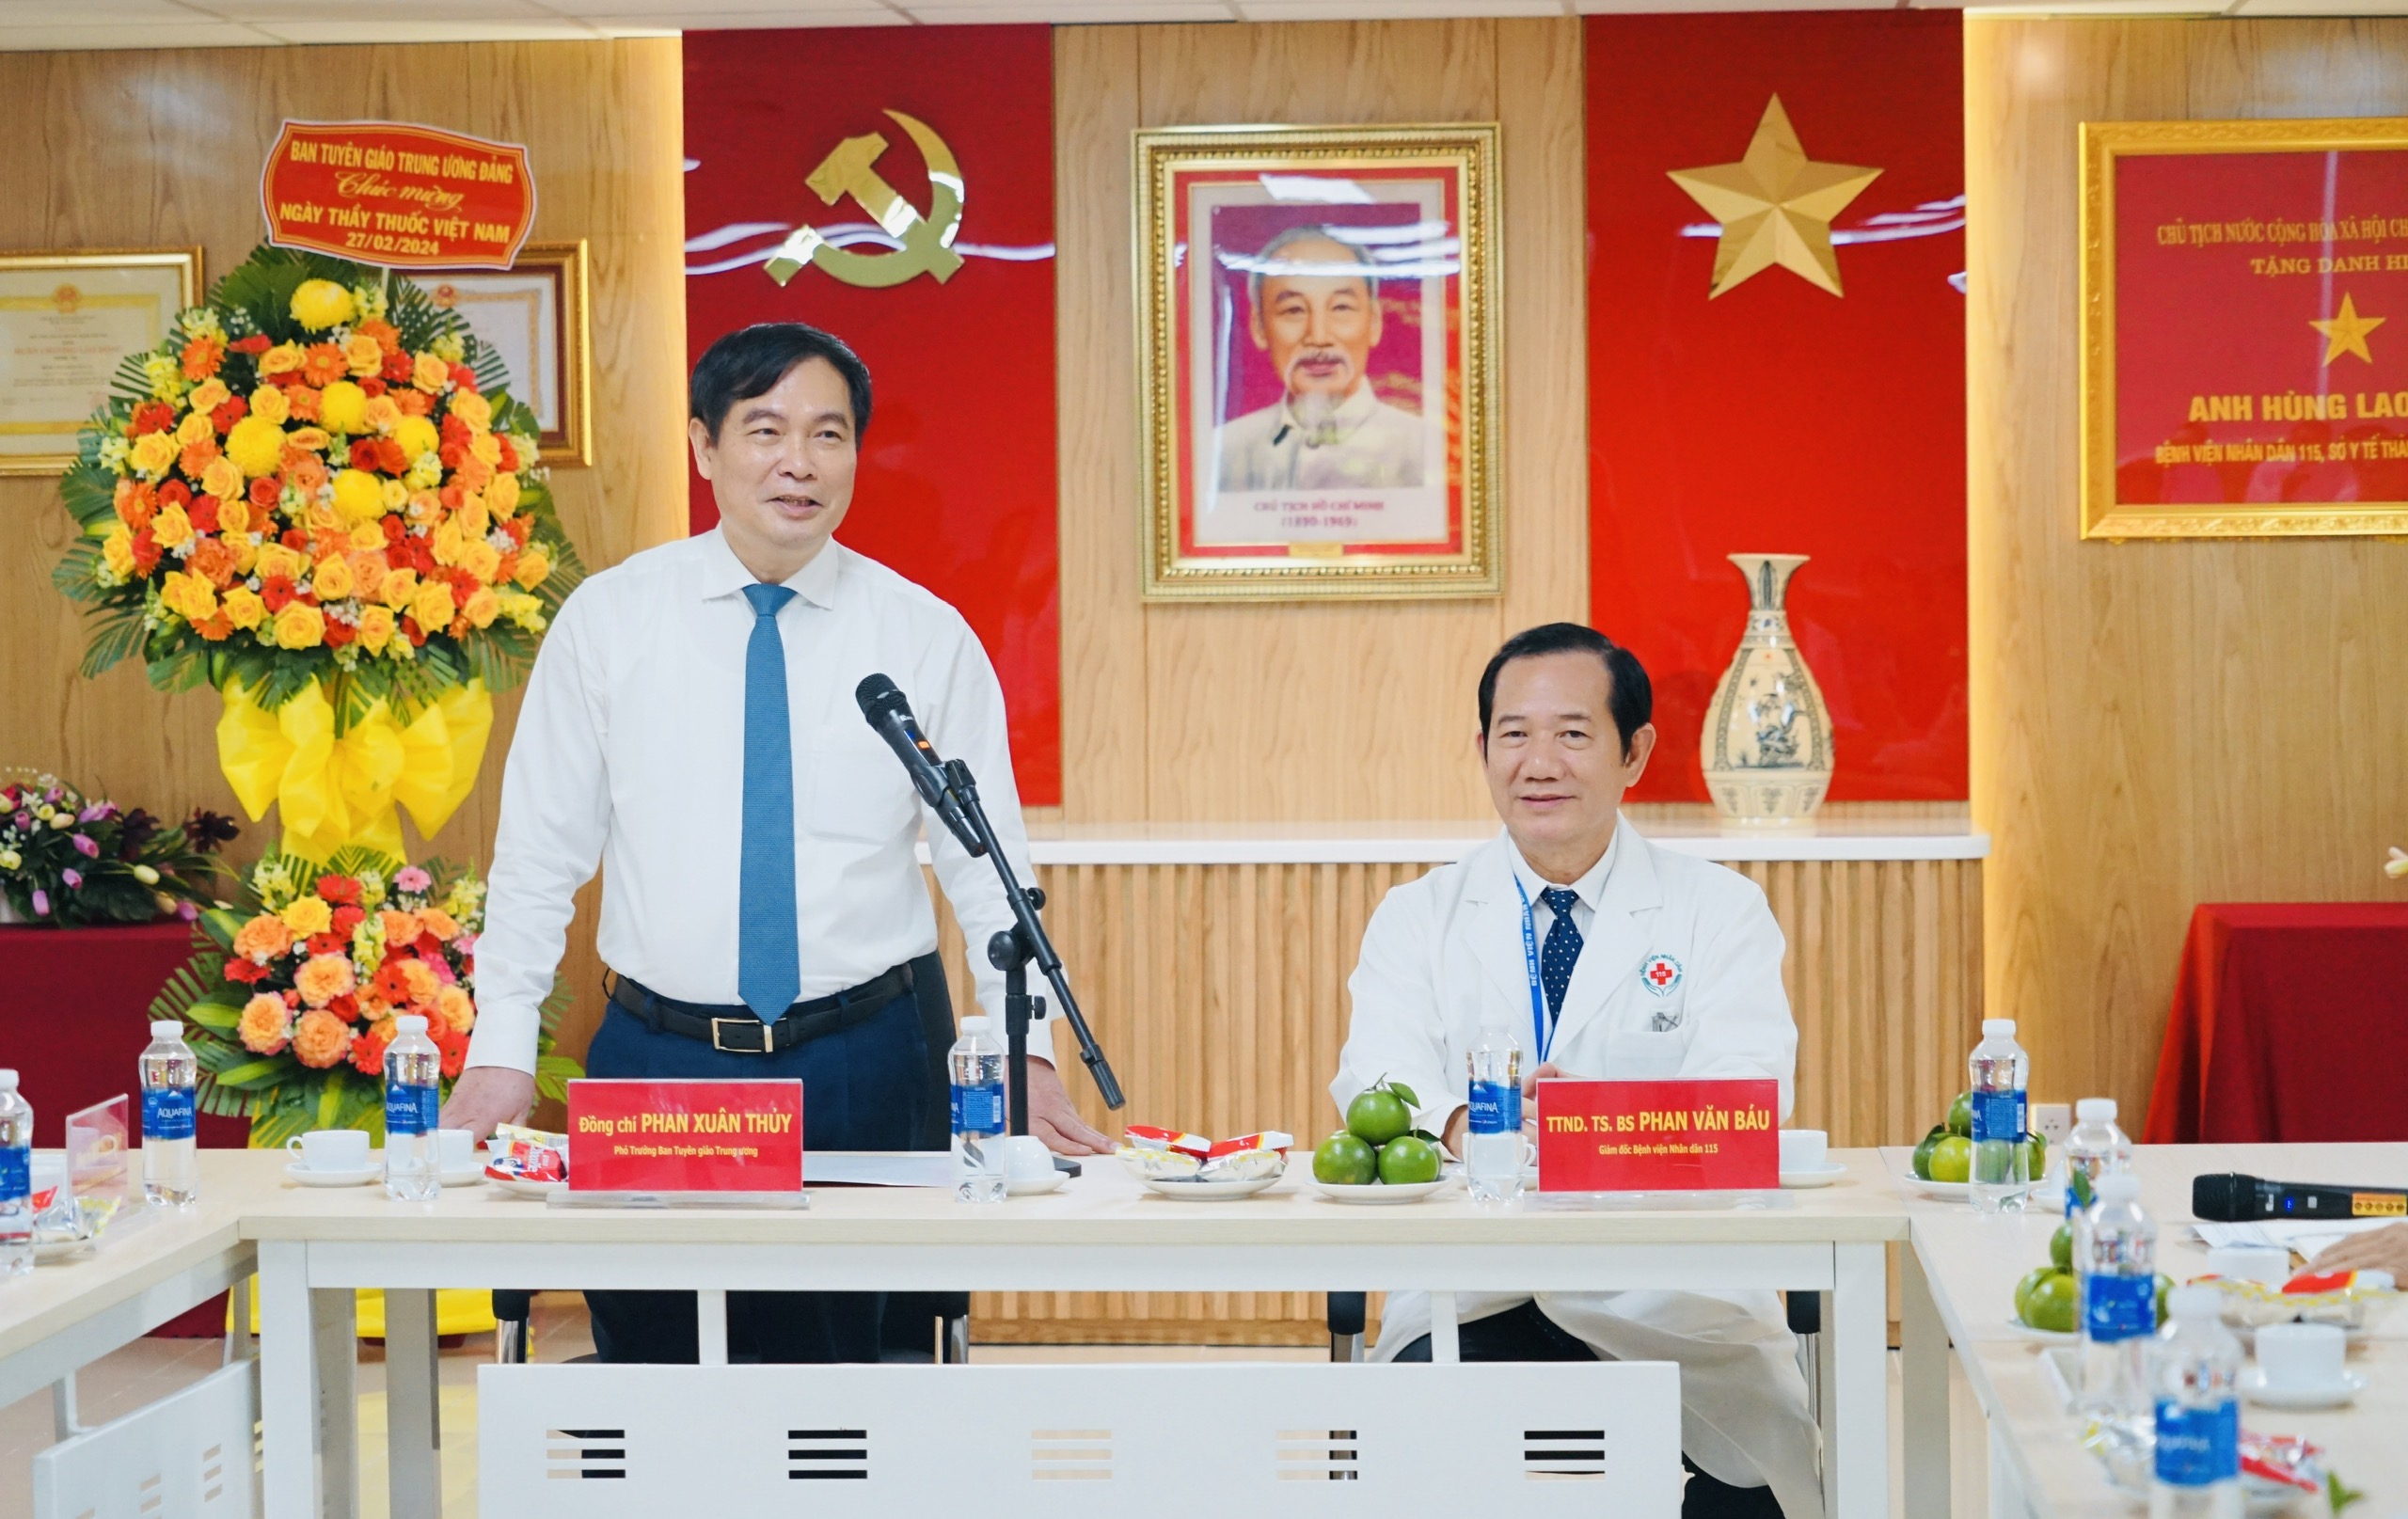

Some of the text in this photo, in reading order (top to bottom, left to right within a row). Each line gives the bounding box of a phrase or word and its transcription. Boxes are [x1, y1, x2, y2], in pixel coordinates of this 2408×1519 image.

[291, 140, 514, 183] BAN TUYÊN GIÁO TRUNG ƯƠNG ĐẢNG
[335, 170, 465, 212] Chúc mừng
[280, 200, 323, 224] NGÀY
[376, 210, 429, 235] THUỐC
[434, 215, 469, 242] VIỆT
[473, 223, 510, 244] NAM
[2158, 217, 2187, 245] CHỦ
[2189, 224, 2222, 248] TỊCH
[2225, 217, 2264, 243] NƯỚC
[2268, 216, 2305, 247] CỘNG
[2362, 214, 2386, 244] HỘI
[345, 232, 439, 256] 27/02/2024
[2251, 255, 2311, 277] TẶNG
[2318, 255, 2380, 274] DANH
[2188, 389, 2408, 421] ANH HÙNG LAO
[2155, 439, 2191, 468] BỆNH
[2192, 438, 2223, 467] VIỆN
[2226, 437, 2263, 462] NHÂN
[2266, 437, 2296, 462] DÂN
[2350, 441, 2359, 460] Y
[2362, 432, 2378, 460] TẾ
[157, 1106, 193, 1119] AQUAFINA
[1468, 1100, 1500, 1114] QUAFINA
[1546, 1104, 1771, 1132] TTND. TS. BS PHAN VĂN BÁU
[579, 1107, 793, 1137] Đồng chí PHAN XUÂN THỦY
[614, 1145, 629, 1156] Phó
[658, 1146, 673, 1156] Ban
[673, 1145, 697, 1158] Tuyên
[698, 1146, 715, 1158] giáo
[715, 1146, 737, 1158] Trung
[1599, 1143, 1719, 1157] Giám đốc Bệnh viện Nhân dân 115
